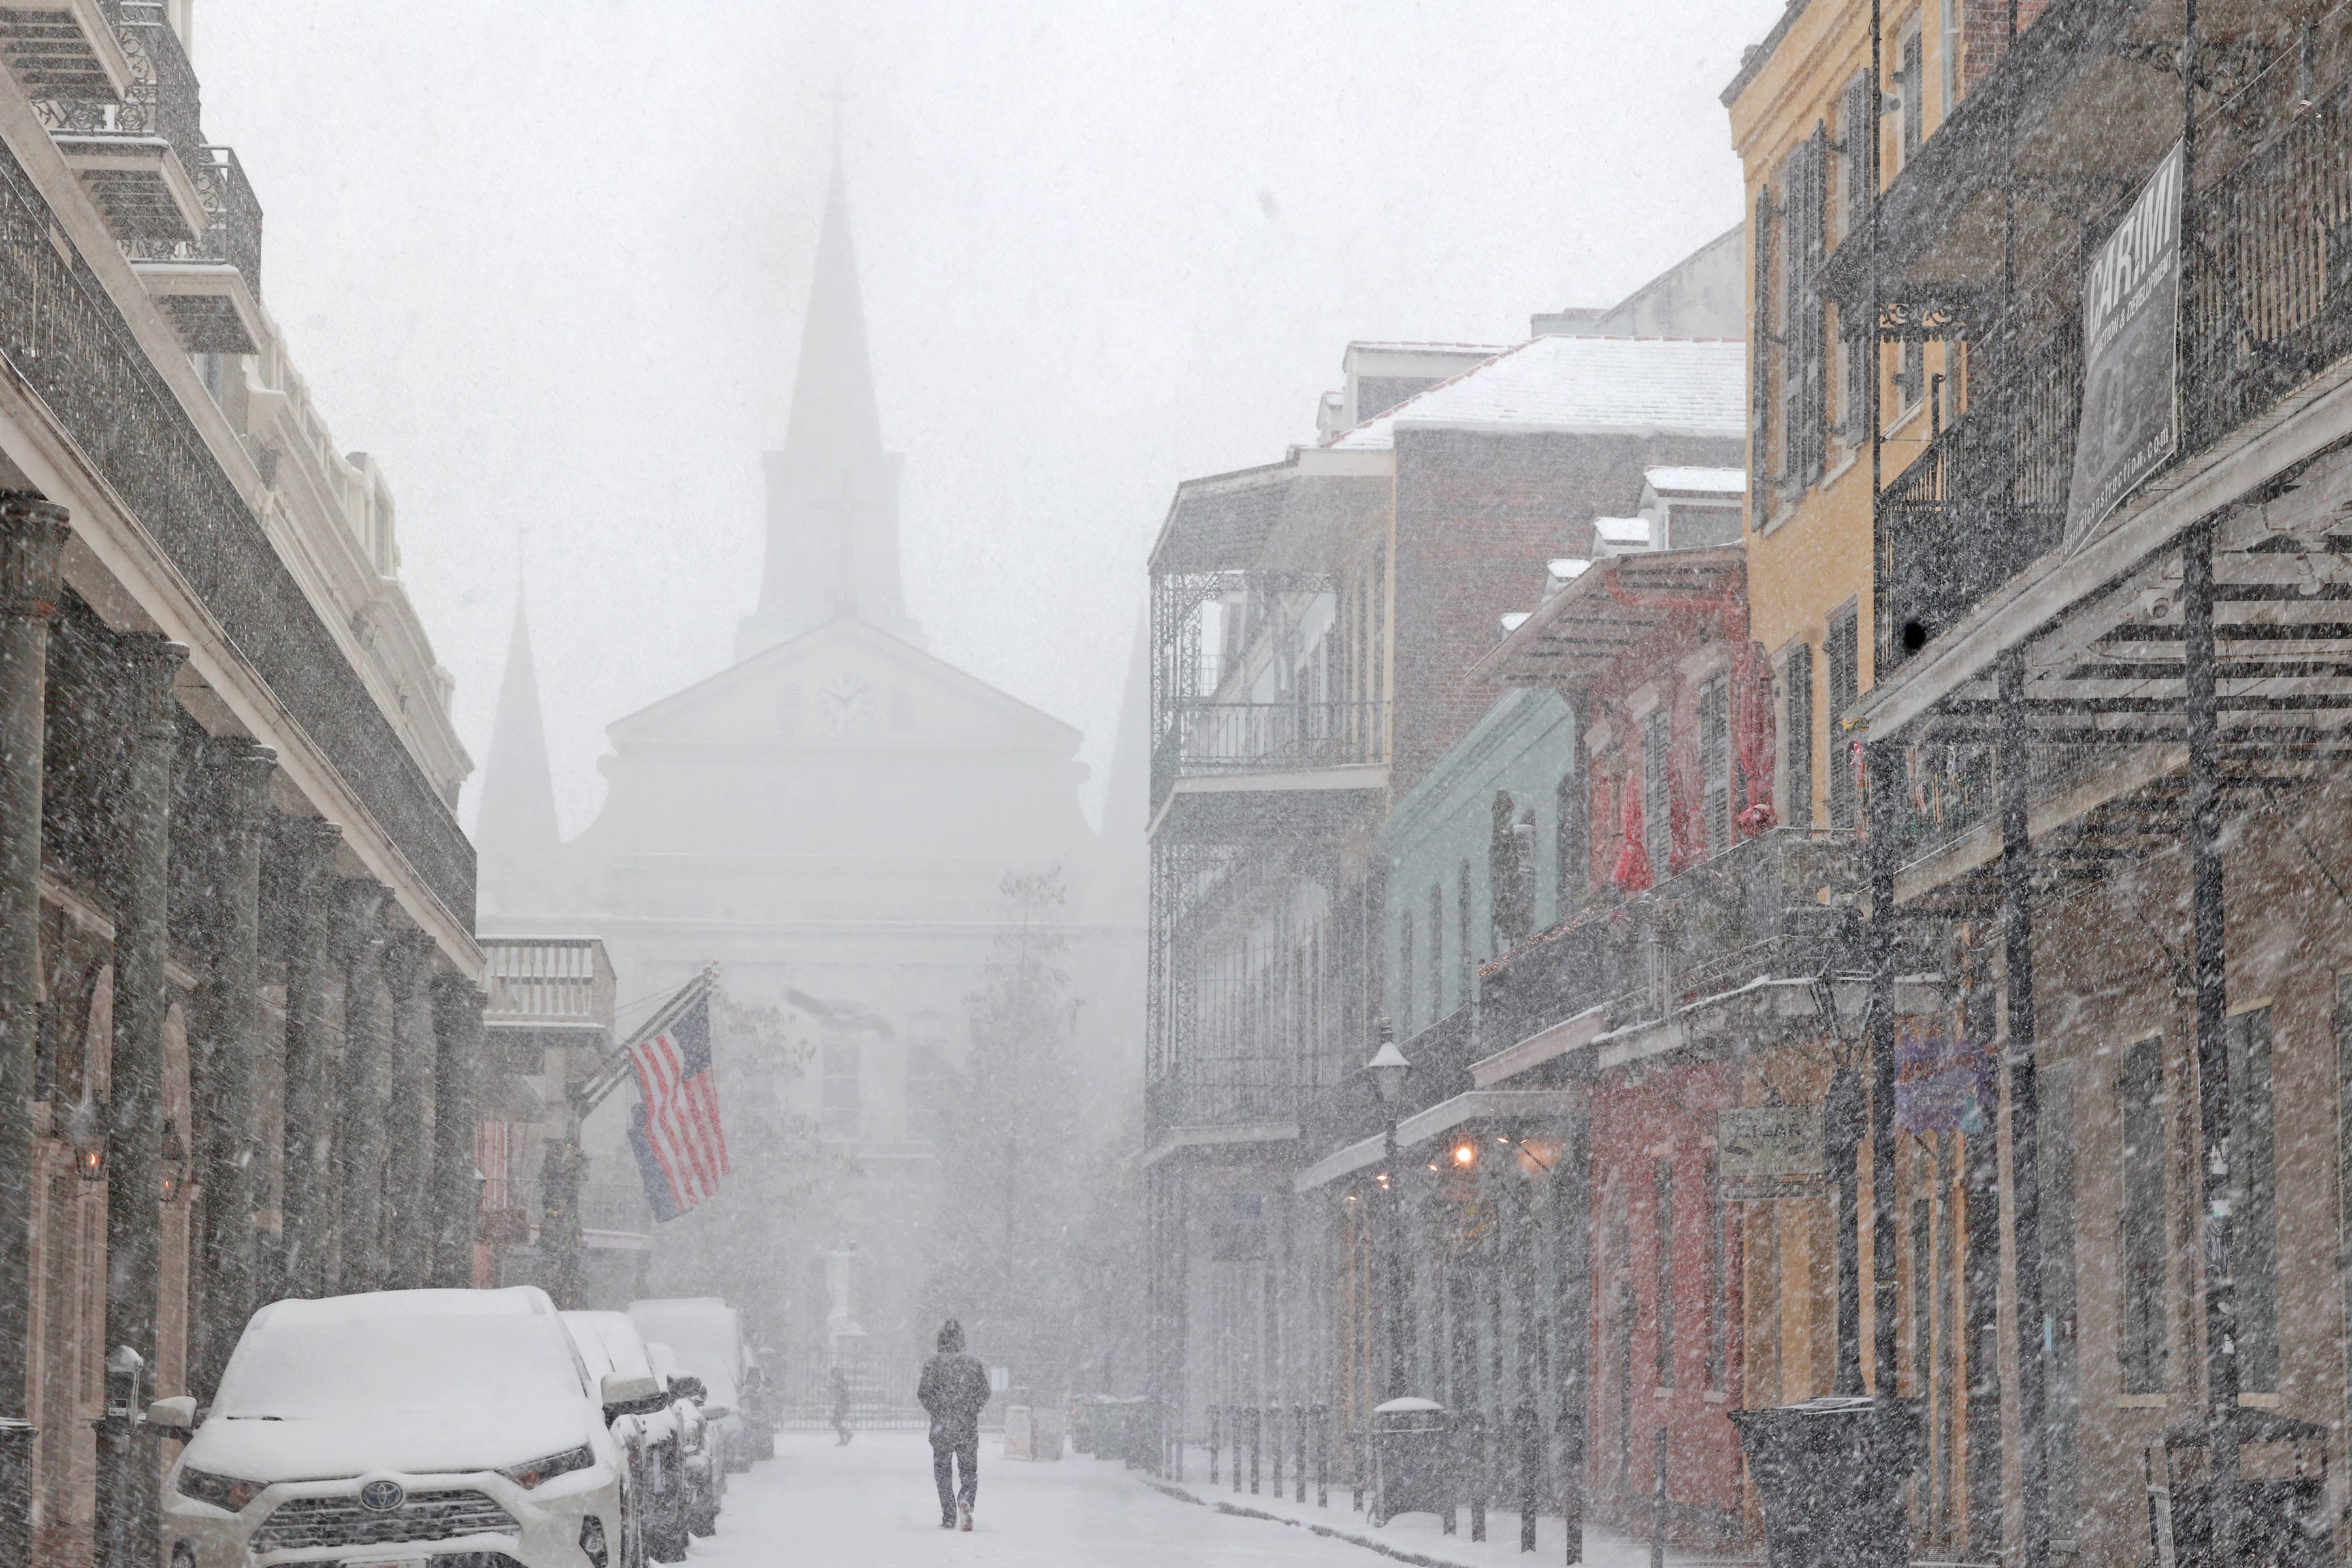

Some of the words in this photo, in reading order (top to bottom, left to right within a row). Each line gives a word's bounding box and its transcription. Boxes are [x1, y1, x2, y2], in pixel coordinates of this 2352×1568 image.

[2090, 156, 2176, 346] CARIMI
[2119, 308, 2126, 327] &
[2126, 248, 2173, 322] DEVELOPMENT
[2064, 427, 2169, 555] carimiconstruction.com
